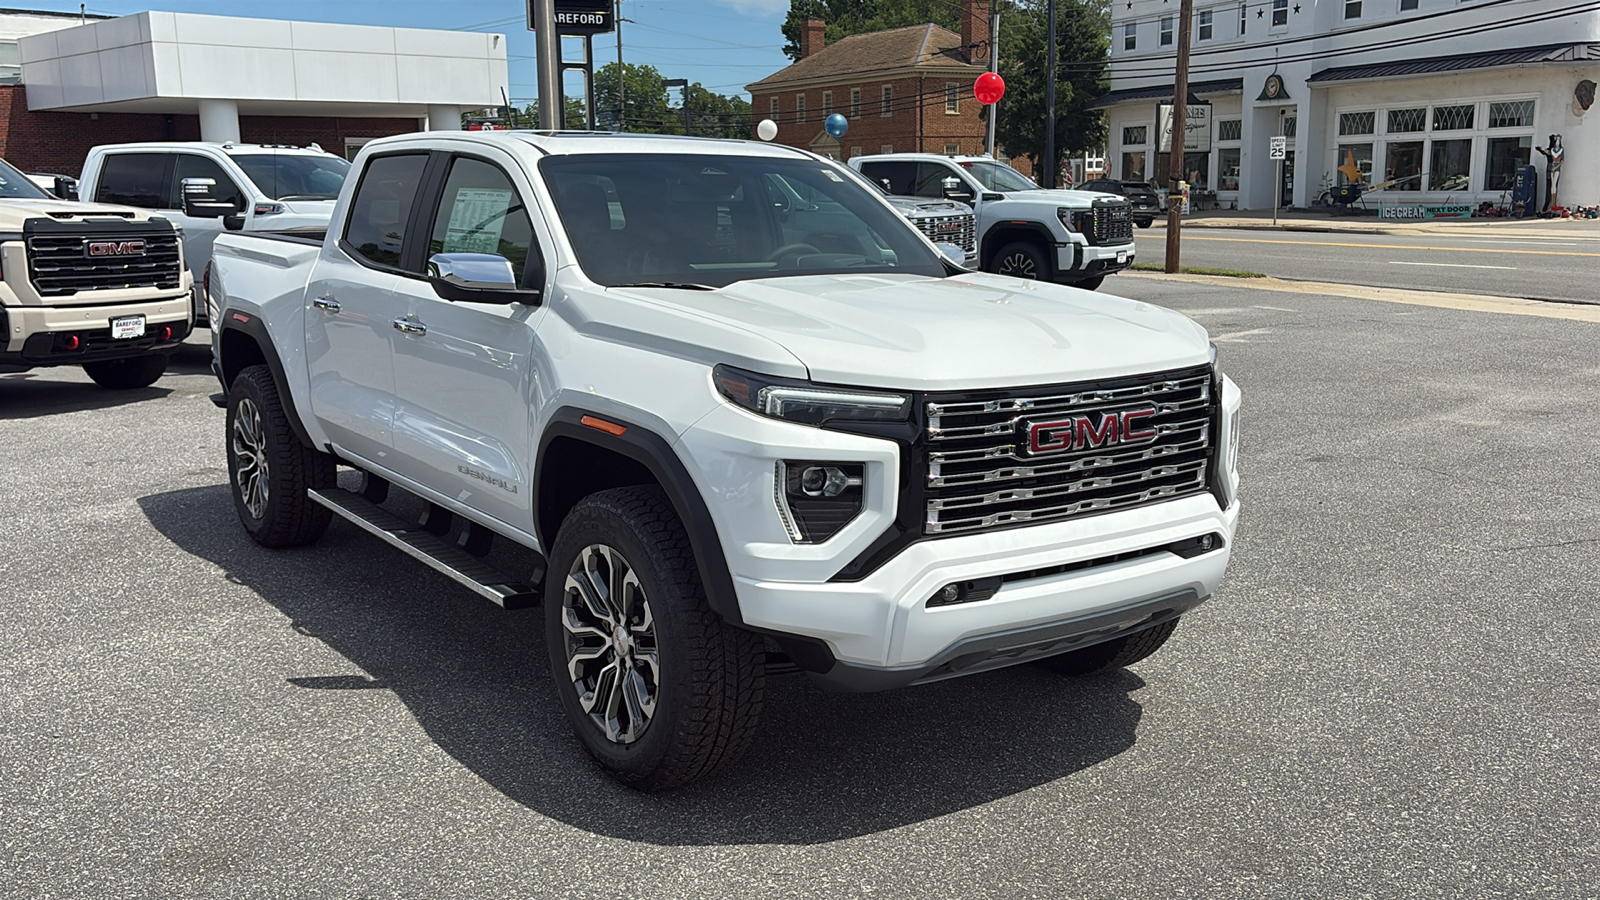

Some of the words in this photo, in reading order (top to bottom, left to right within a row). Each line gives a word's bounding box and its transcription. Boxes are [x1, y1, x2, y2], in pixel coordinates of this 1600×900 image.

[554, 13, 604, 25] REFORD
[1271, 147, 1284, 157] 25
[1382, 207, 1397, 218] ICE
[1397, 207, 1425, 218] CREAM
[89, 241, 145, 256] GMC
[115, 319, 142, 328] BAREFORD
[1026, 407, 1157, 456] GMC
[457, 464, 518, 495] DENALI
